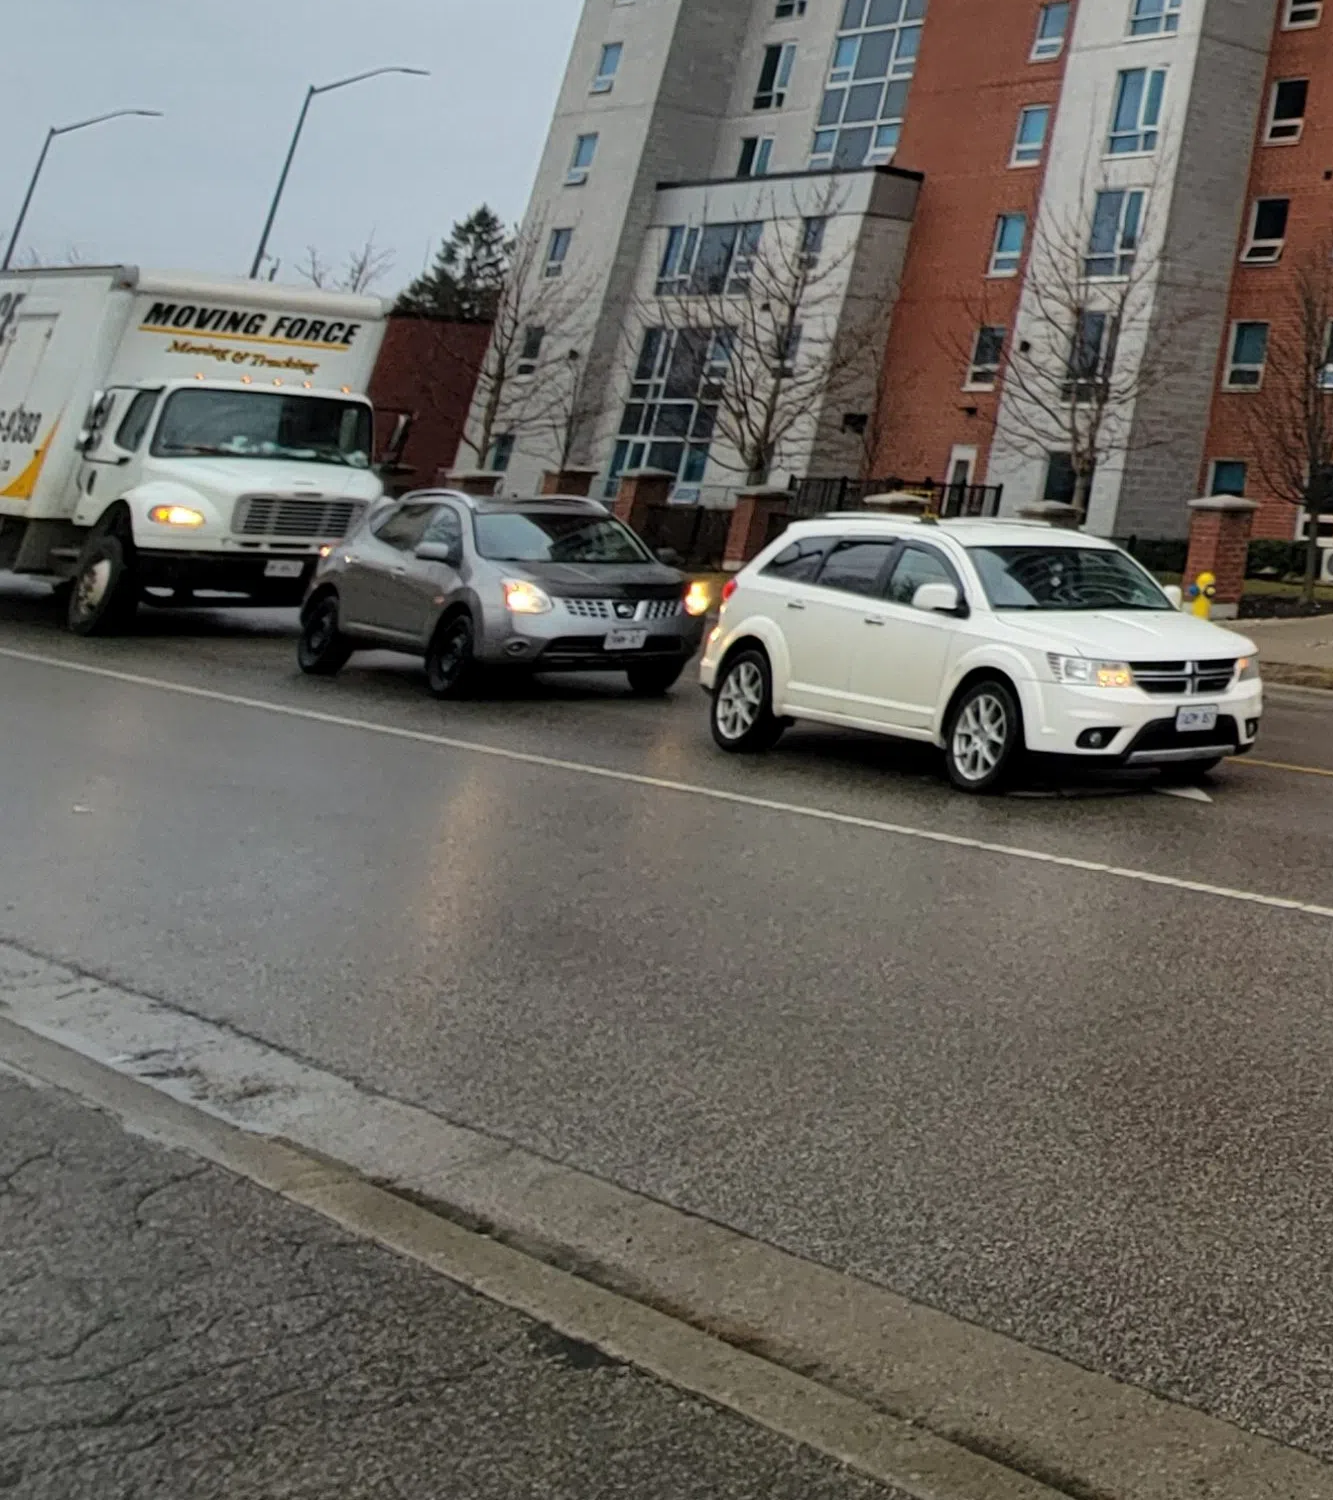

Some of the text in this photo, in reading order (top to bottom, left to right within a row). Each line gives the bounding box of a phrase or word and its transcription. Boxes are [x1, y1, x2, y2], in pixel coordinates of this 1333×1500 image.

[143, 302, 361, 345] MOVING FORCE
[165, 340, 231, 361] Moving
